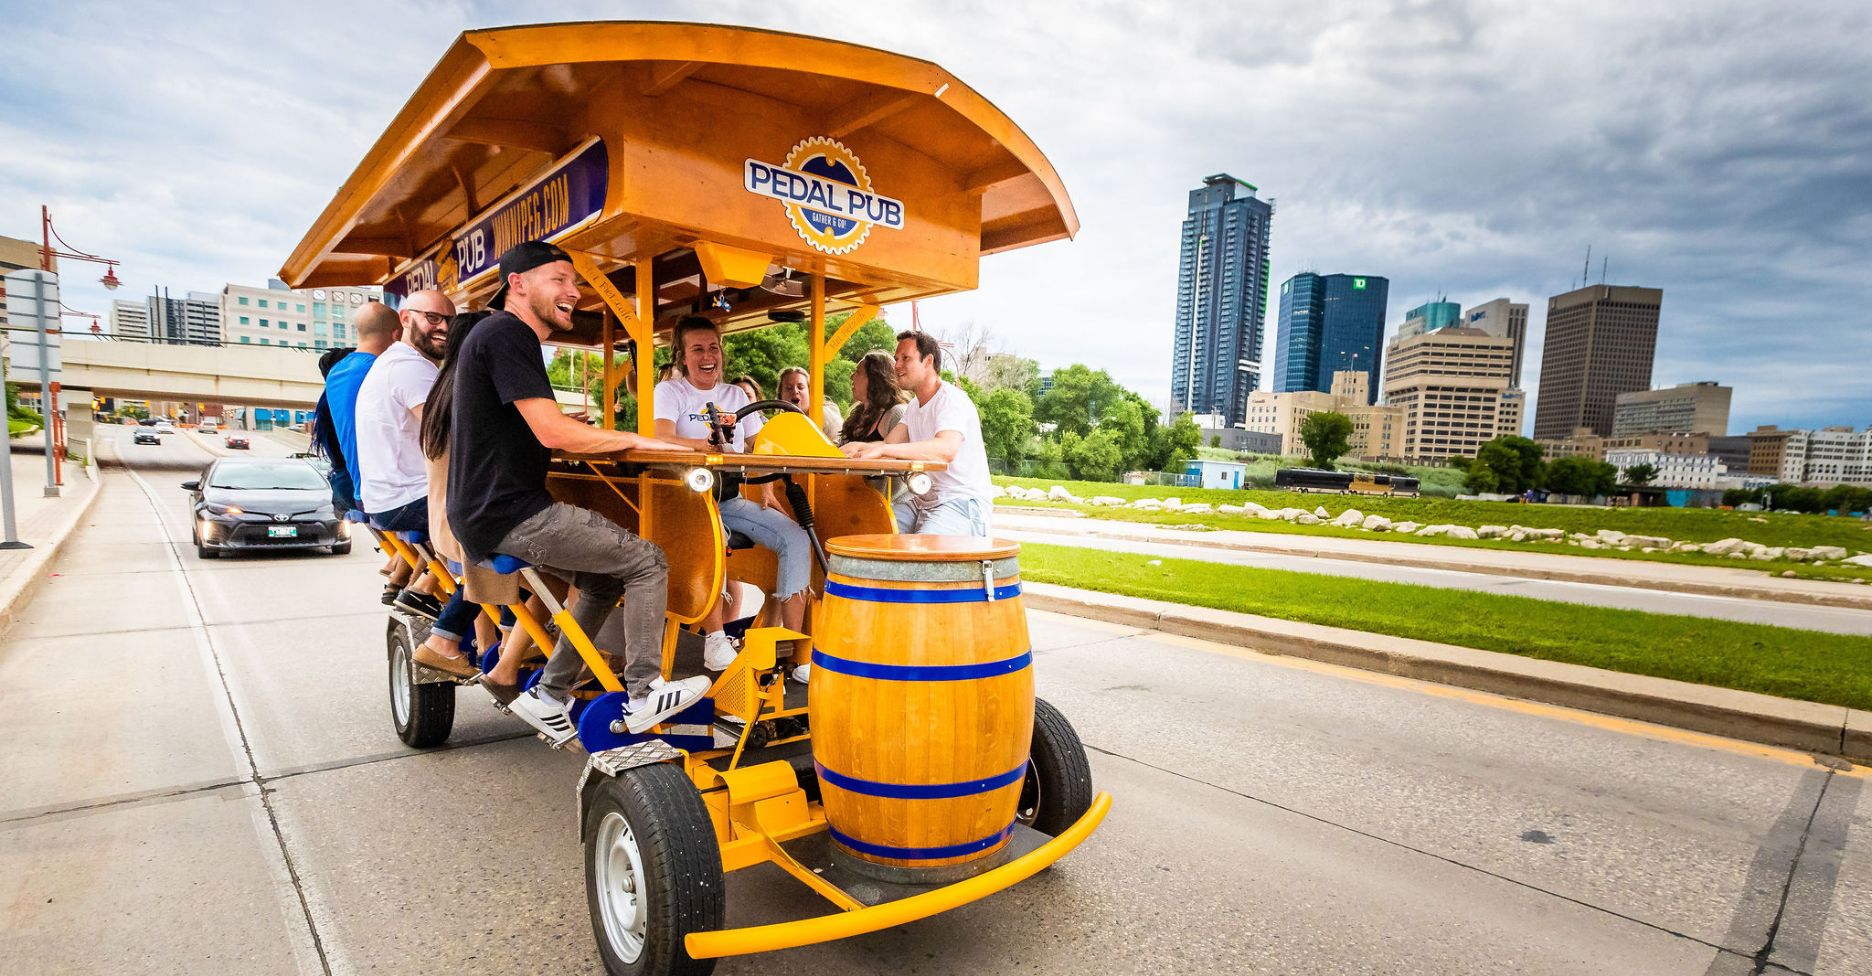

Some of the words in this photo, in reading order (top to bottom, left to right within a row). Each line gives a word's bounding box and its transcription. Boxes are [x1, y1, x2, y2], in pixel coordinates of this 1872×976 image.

[457, 228, 485, 278] PUB
[491, 173, 570, 260] WINNIPEG.COM
[750, 162, 842, 212] PEDAL
[848, 189, 901, 226] PUB
[812, 212, 832, 226] GATHER
